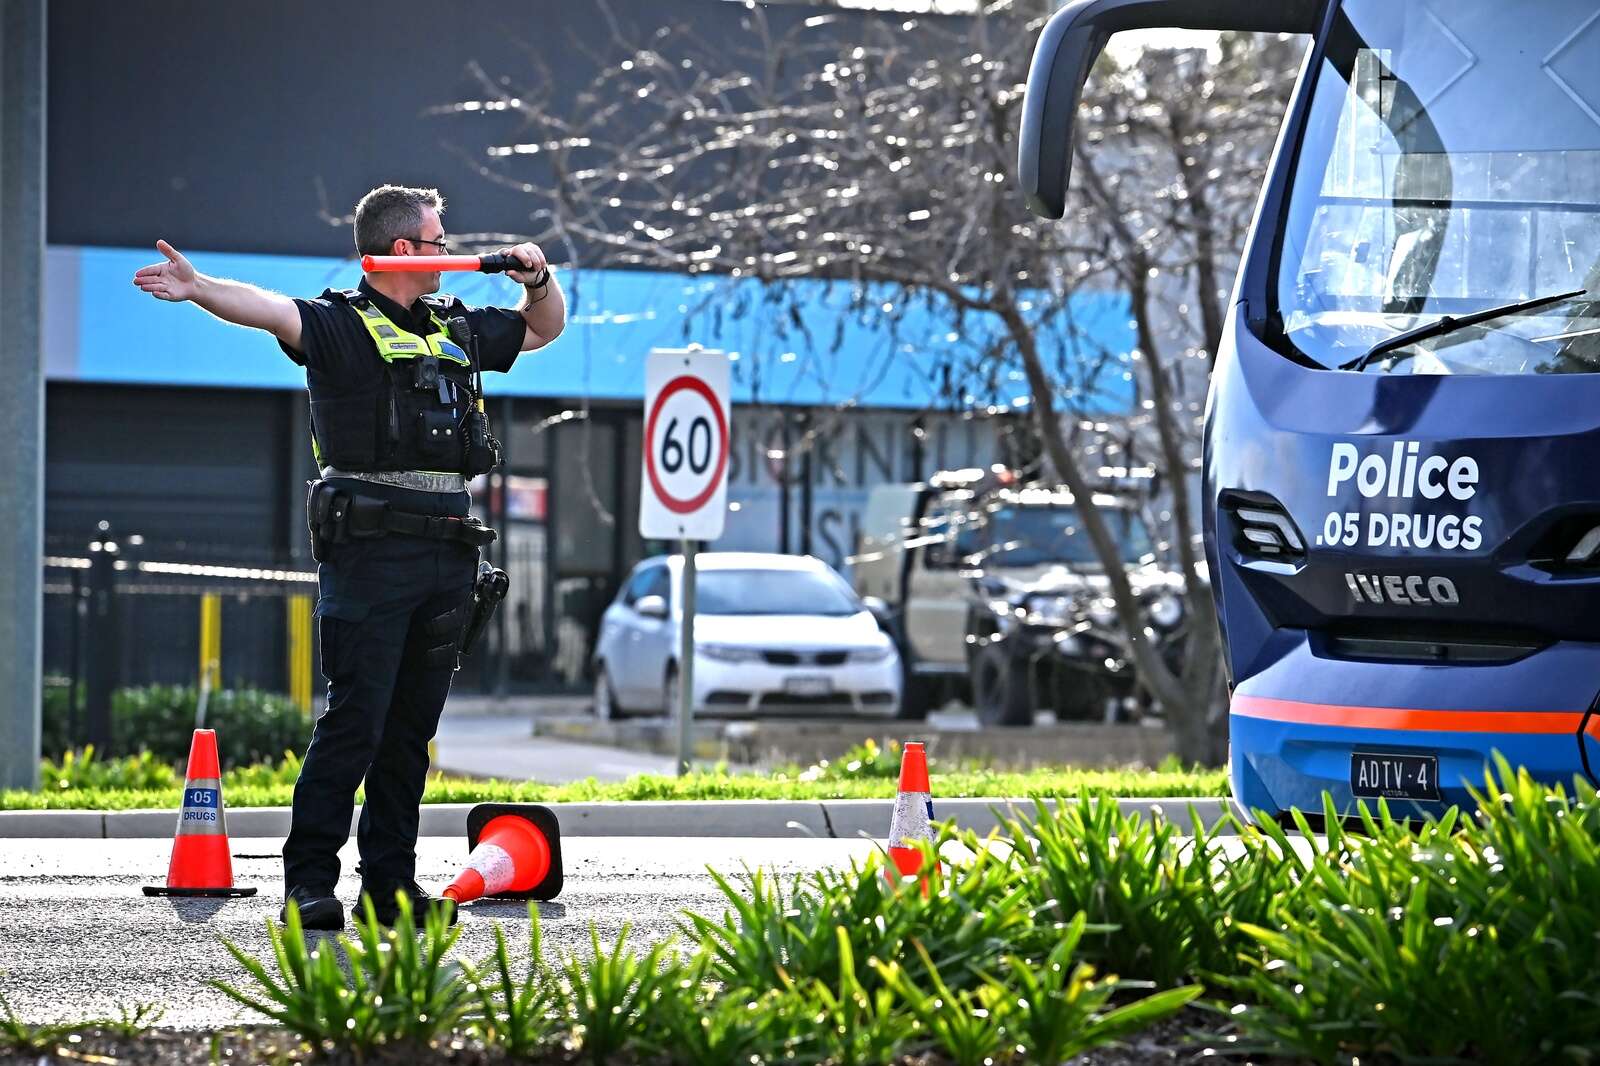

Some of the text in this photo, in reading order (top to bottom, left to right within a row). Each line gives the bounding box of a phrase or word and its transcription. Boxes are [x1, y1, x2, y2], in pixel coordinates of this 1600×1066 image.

[661, 415, 712, 475] 60
[1327, 441, 1479, 501] Police
[1316, 511, 1483, 551] .05 DRUGS
[1344, 573, 1460, 606] IVECO
[184, 811, 216, 821] DRUGS
